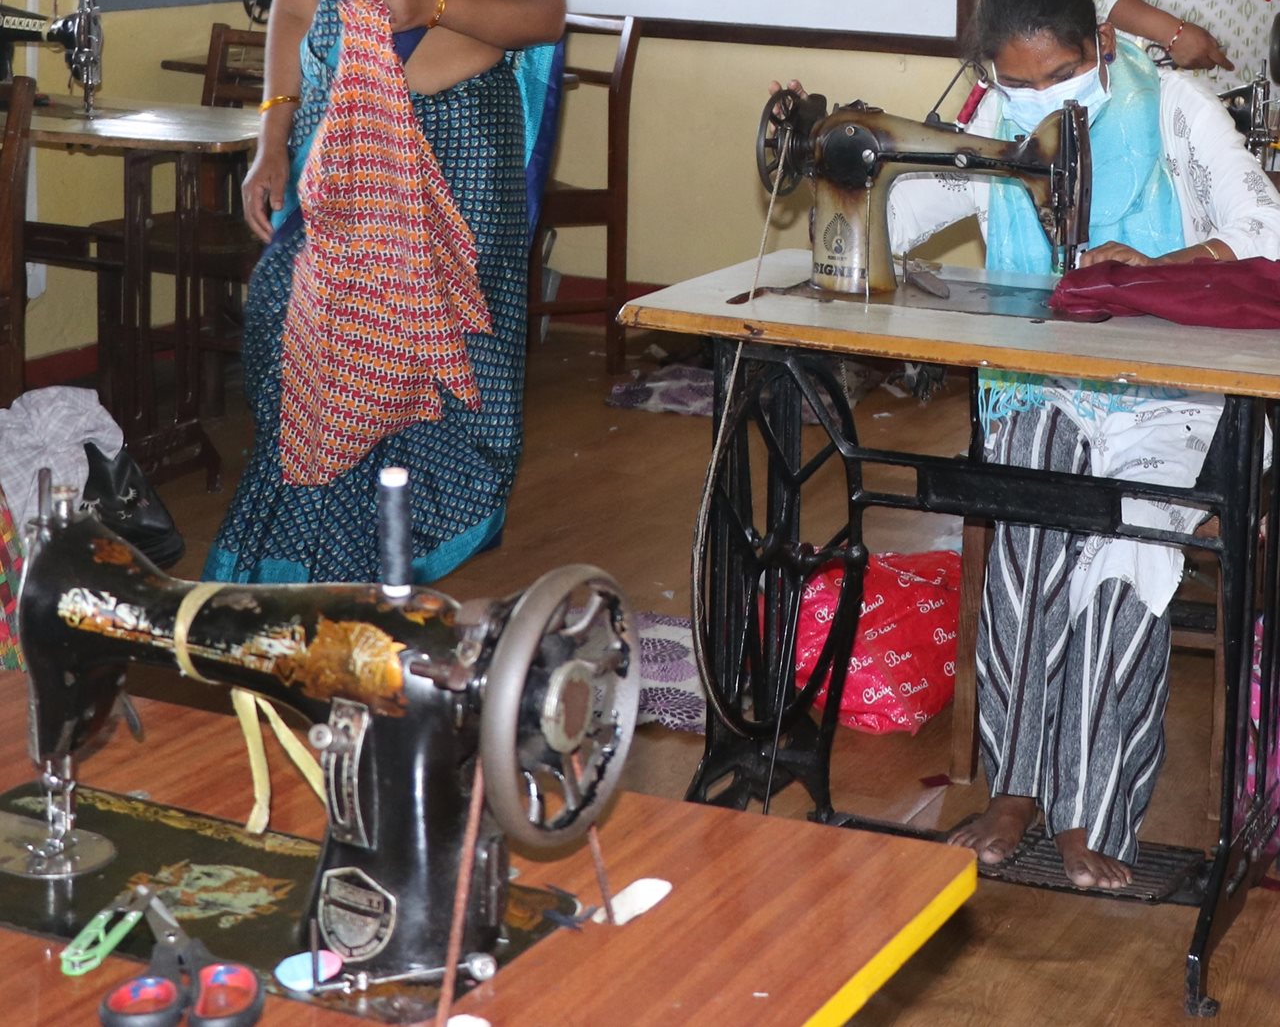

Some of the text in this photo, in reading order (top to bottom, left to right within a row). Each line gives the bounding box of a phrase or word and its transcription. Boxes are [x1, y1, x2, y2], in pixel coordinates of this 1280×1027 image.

[815, 607, 835, 624] Clo
[859, 594, 885, 618] loud
[884, 649, 913, 668] Bee
